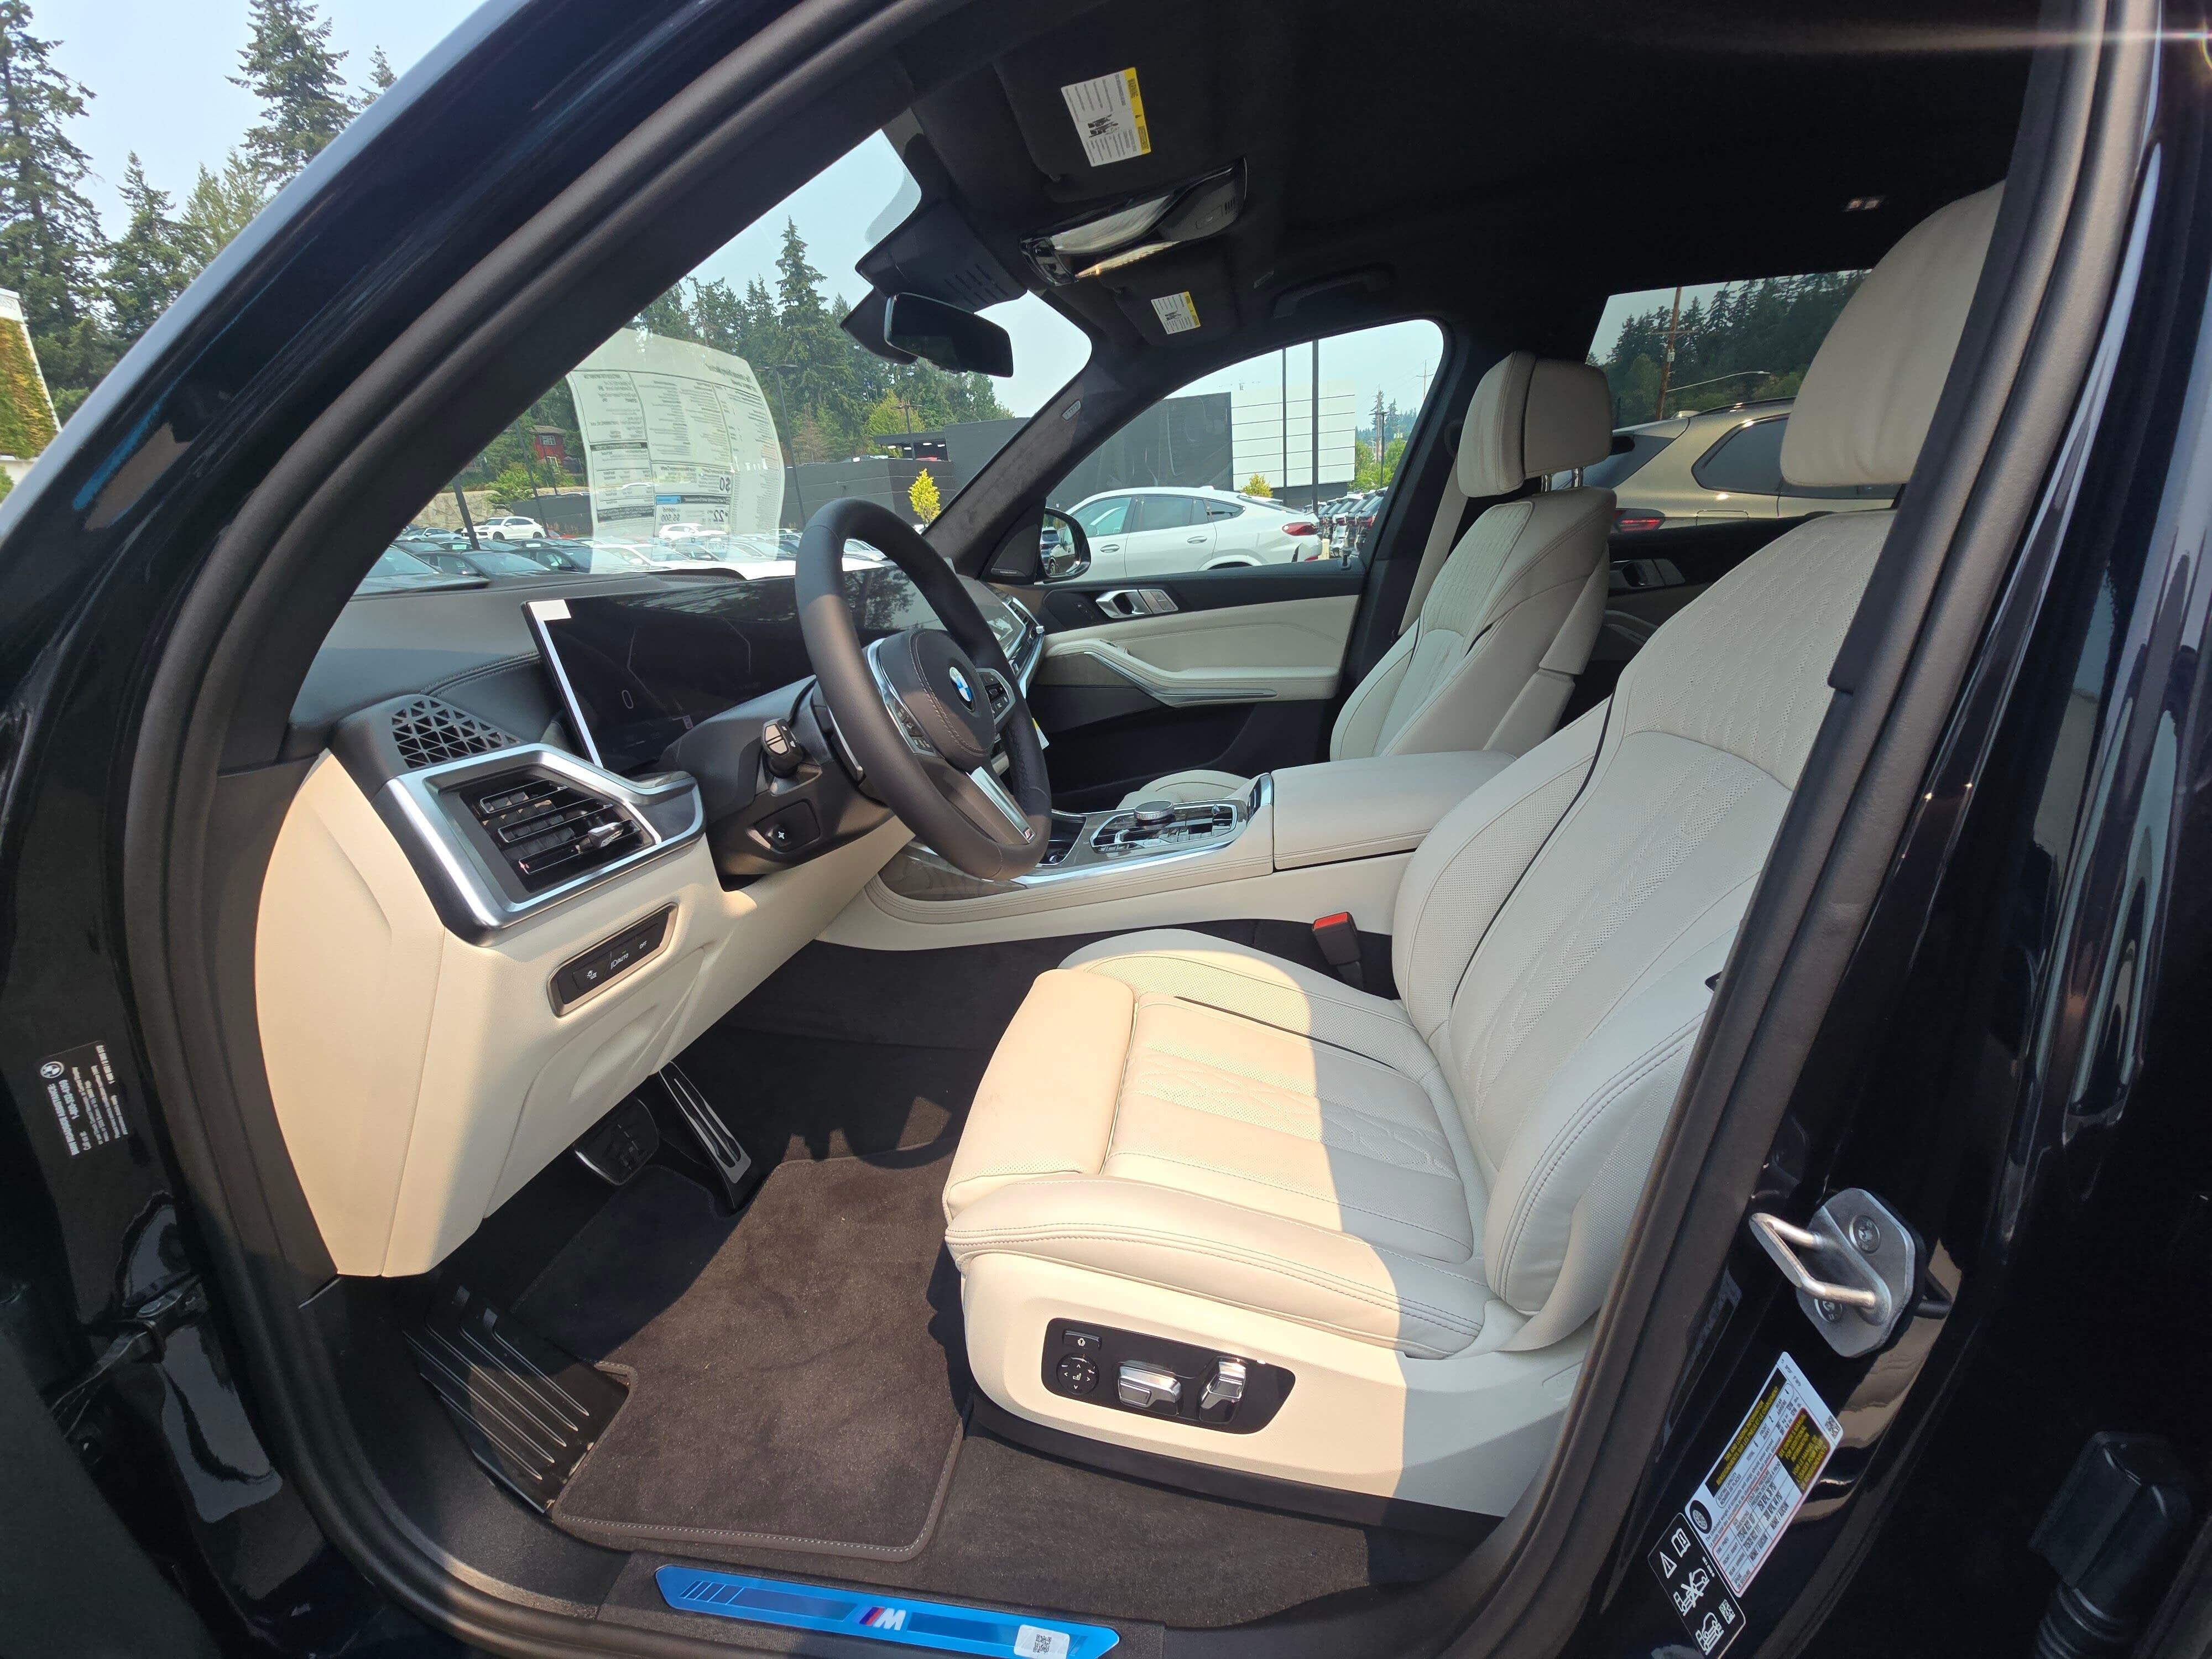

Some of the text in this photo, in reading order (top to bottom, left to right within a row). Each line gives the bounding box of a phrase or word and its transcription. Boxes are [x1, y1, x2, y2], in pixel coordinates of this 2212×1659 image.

[639, 940, 648, 950] OFF
[617, 953, 629, 963] AUTO
[58, 1115, 76, 1143] ROADSIDE
[67, 1140, 80, 1156] BMW
[873, 1606, 907, 1631] M
